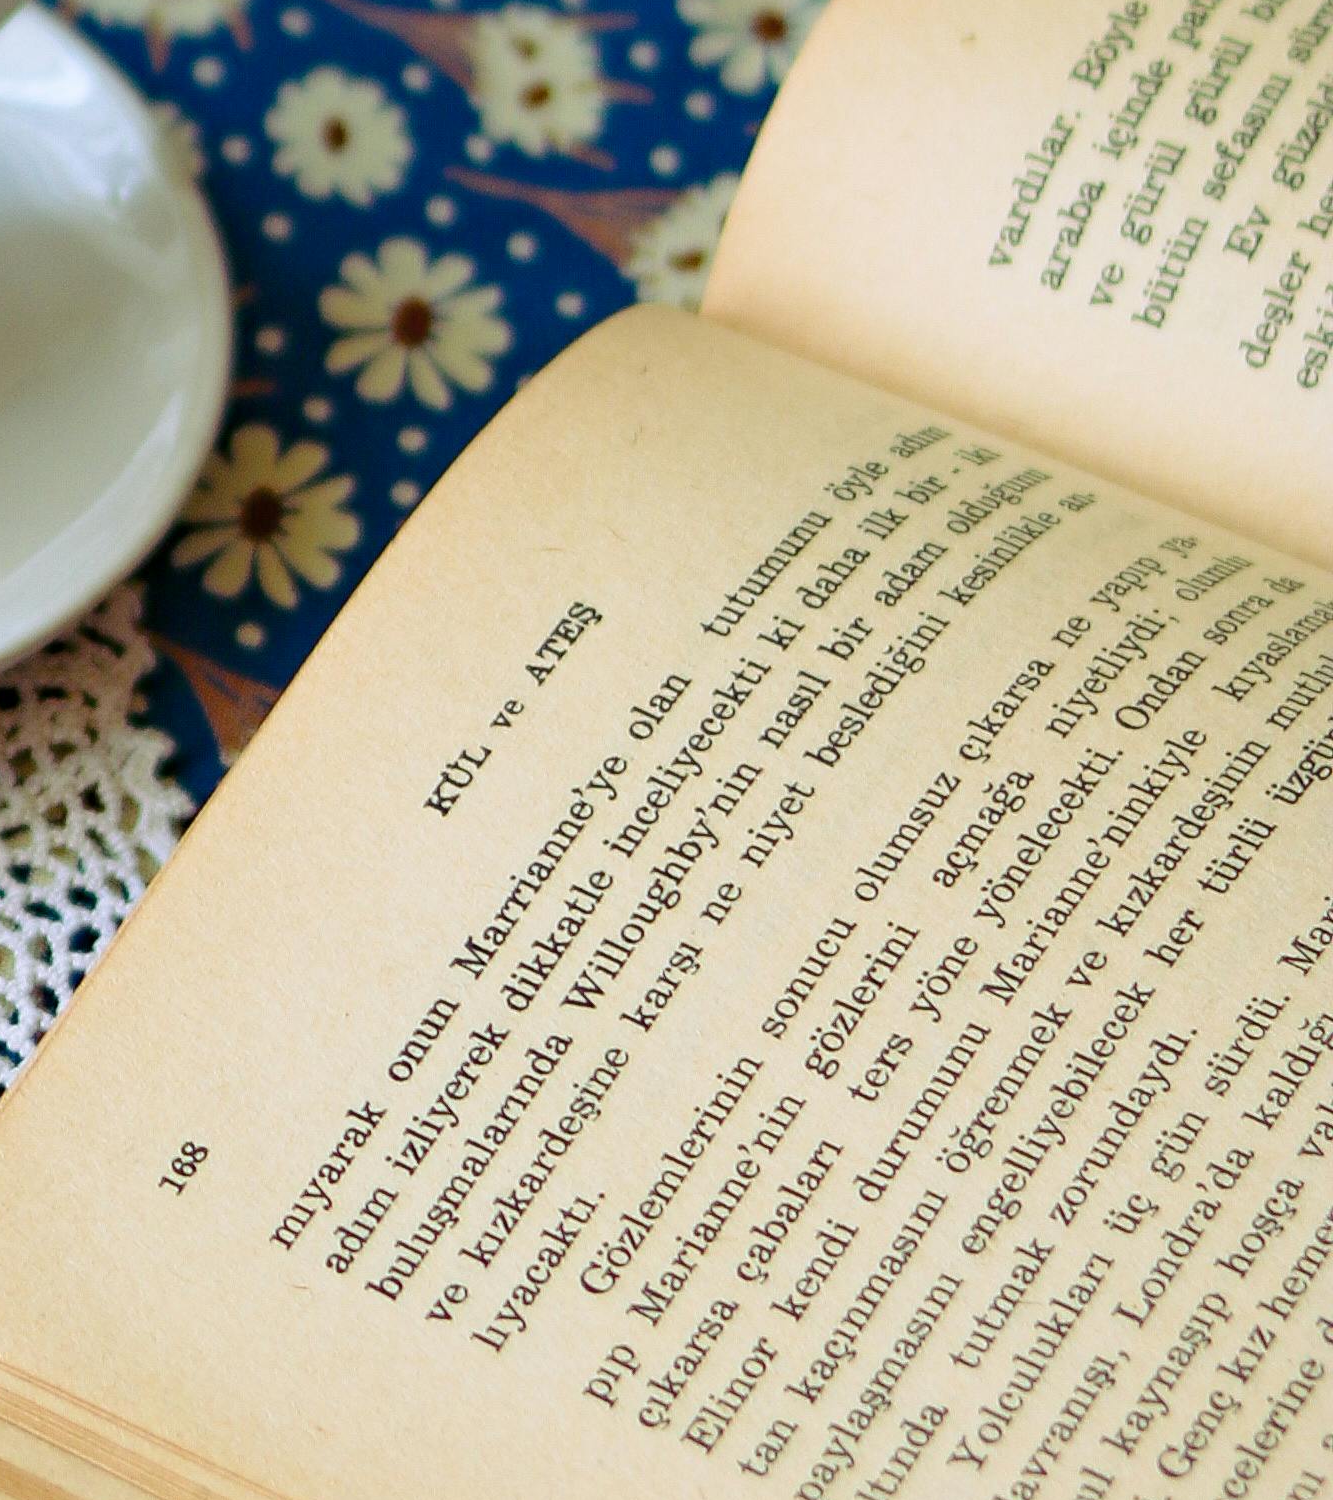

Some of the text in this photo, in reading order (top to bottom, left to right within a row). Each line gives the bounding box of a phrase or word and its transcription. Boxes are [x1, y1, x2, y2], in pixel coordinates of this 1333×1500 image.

[988, 112, 1081, 267] vardılar.
[1069, 0, 1149, 91] Böyle
[1040, 180, 1107, 292] araba
[1092, 59, 1173, 161] içinde
[1089, 263, 1125, 306] ve
[1120, 141, 1188, 247] gürül
[1184, 37, 1254, 127] gürül
[1131, 217, 1209, 330] bütün
[1203, 74, 1293, 202] sefasını
[1223, 82, 1333, 263] Ev güzeld
[1239, 181, 1333, 370] deşler he
[269, 427, 951, 1251] mıyarak onun Marrianne'ye olan tutumunu öyle adım
[423, 601, 603, 817] KÜL ve ATEŞ
[325, 1188, 399, 1275] adım
[385, 1023, 511, 1176] izliyerek
[500, 870, 614, 1013] dikkatle
[602, 657, 772, 858] inceliyecekti
[757, 615, 806, 651] ki
[796, 548, 871, 610] daha
[857, 508, 909, 541] ilk
[894, 476, 948, 505] bir
[364, 469, 1052, 1302] buluşmalarında Willoughby'nin nasıl bir adam olduğunu
[425, 1284, 469, 1321] ve
[458, 1048, 629, 1269] kızkardeşine
[619, 942, 704, 1033] karşı
[700, 883, 743, 926] ne
[740, 782, 816, 869] niyet
[803, 611, 951, 768] beslediğini
[937, 513, 1062, 607] kesinlikle
[580, 1057, 764, 1295] Gözlemlerinin
[761, 917, 858, 1040] sonucu
[854, 772, 962, 902] olumsuz
[959, 660, 1056, 763] çıkarsa
[1051, 616, 1091, 649] ne
[1089, 557, 1167, 613] yapıp
[582, 556, 1254, 1409] pıp Marianne'nin gözlerini açmağa niyetliydi; olumlu
[638, 577, 1305, 1429] çıkarsa çabaları ters yöne yönelecekti. Ondan sonra da
[158, 1141, 210, 1196] 168
[680, 1337, 778, 1455] Elinor
[769, 1218, 859, 1323] kendi
[853, 1022, 992, 1203] durumunu
[979, 730, 1207, 1006] Marianne'ninkiyle
[738, 1420, 799, 1478] tan
[784, 1190, 949, 1405] kaçınmasını
[935, 1003, 1073, 1174] öğrenmek
[1065, 951, 1108, 986] ve
[1095, 740, 1271, 938] kızkardeşinin
[946, 895, 1333, 1472] Yolculukları üç gün sürdü. Mar
[961, 982, 1156, 1255] engelliyebilecek
[1143, 909, 1205, 968] her
[1197, 817, 1278, 894] türlü
[470, 1193, 606, 1354] lıyacaktı.
[949, 1238, 1055, 1369] tutmak
[1049, 1029, 1198, 1227] zorundaydı.
[1100, 1293, 1233, 1457] kaynaşıp
[1214, 1179, 1305, 1279] hoşça
[1111, 1149, 1255, 1329] Londra'da
[1157, 1391, 1243, 1480] Genç
[1216, 1325, 1277, 1385] kız
